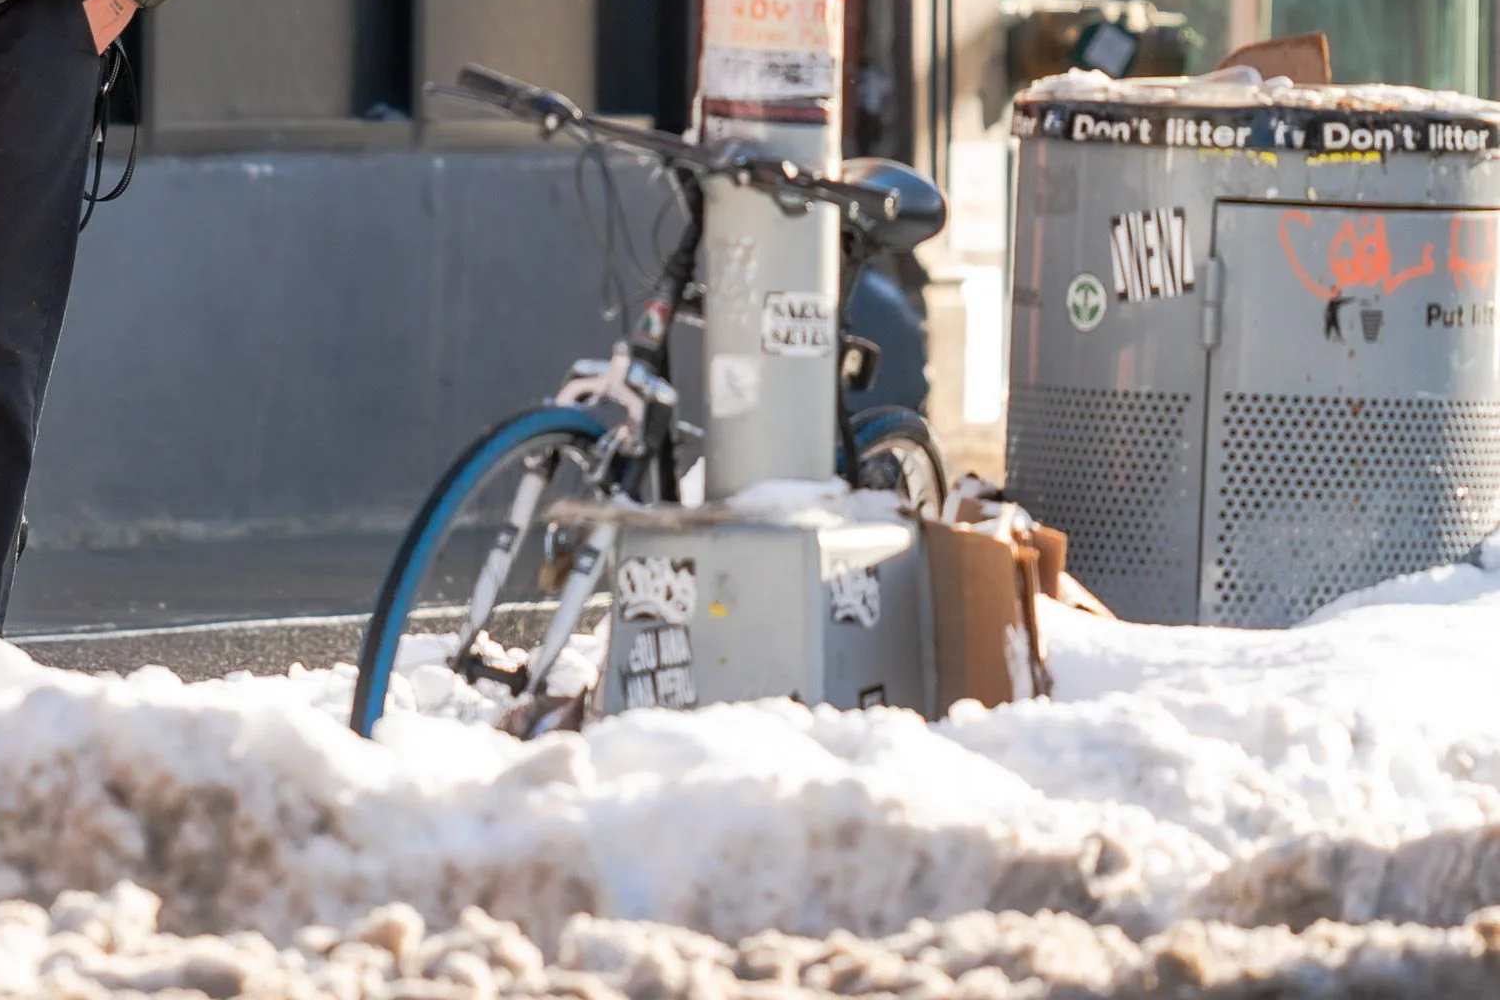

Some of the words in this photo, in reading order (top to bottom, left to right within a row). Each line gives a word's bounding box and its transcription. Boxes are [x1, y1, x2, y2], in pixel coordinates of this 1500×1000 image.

[1072, 113, 1152, 145] Don't
[1165, 117, 1252, 148] litter
[1322, 121, 1417, 151] Don't
[1428, 123, 1490, 151] litter
[1426, 302, 1463, 328] Put
